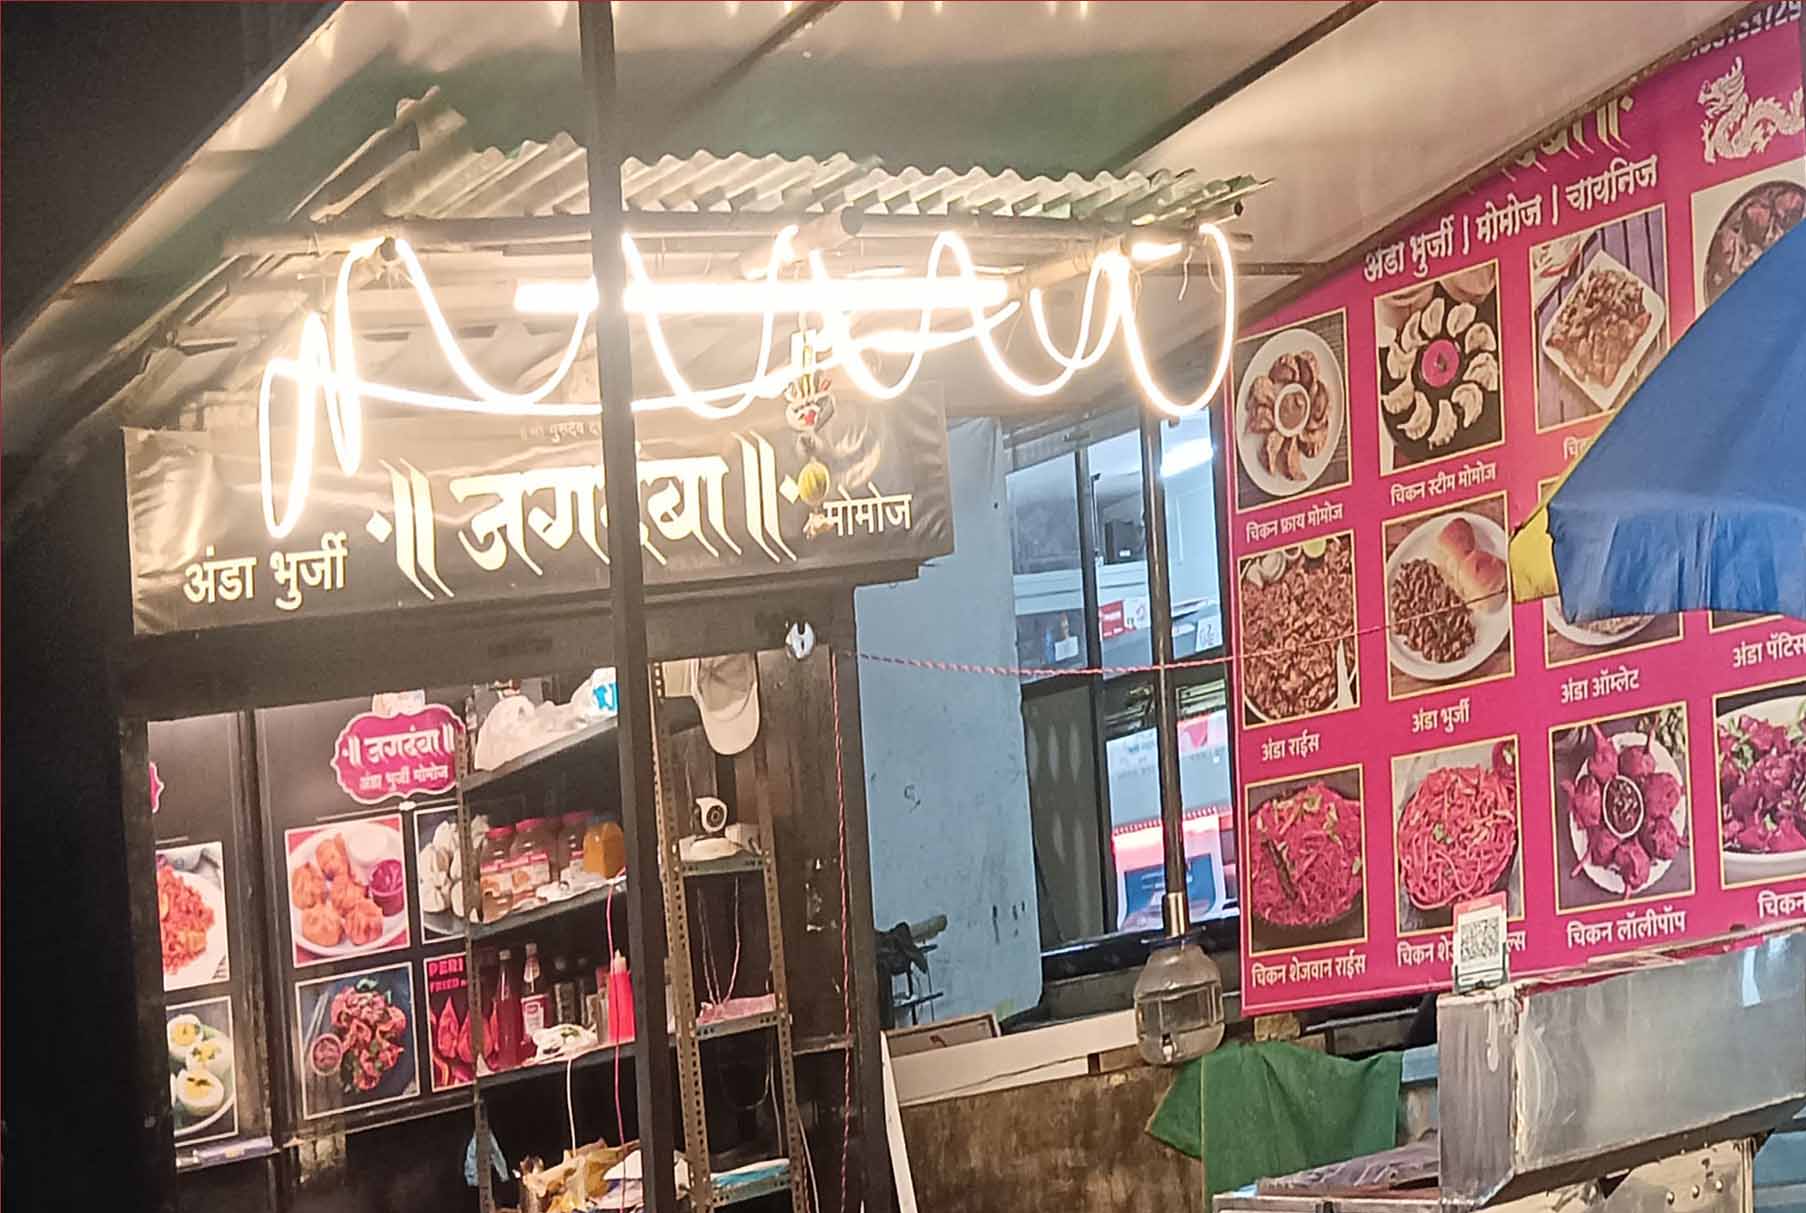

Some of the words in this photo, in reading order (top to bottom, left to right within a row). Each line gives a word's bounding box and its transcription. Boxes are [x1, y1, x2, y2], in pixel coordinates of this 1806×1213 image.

[1476, 192, 1542, 243] मोमोज
[1566, 154, 1658, 211] चायनिज
[1391, 484, 1425, 507] चिकन
[1428, 473, 1455, 496] स्टीम
[1458, 462, 1496, 490] मोमोज
[822, 481, 913, 537] मोमोज
[1246, 520, 1278, 544] चिकन
[1280, 513, 1305, 537] फ्राय
[1307, 502, 1344, 529] मोमोज
[183, 545, 257, 603] अंडा
[270, 531, 348, 610] भुर्जी
[1732, 640, 1762, 667] अंडा
[1561, 677, 1588, 704] अंडा
[1592, 664, 1640, 698] ऑम्लेट
[1412, 708, 1438, 734] अंडा
[1440, 698, 1470, 734] भुर्जी
[1261, 738, 1286, 762] अंडा
[1288, 728, 1320, 759] राईस
[1567, 920, 1613, 949] चिकन
[1616, 906, 1686, 941] लॉलीपॉप
[1252, 964, 1286, 988] चिकन
[1289, 955, 1332, 983] शेजवान
[1335, 949, 1365, 978] राईस
[1397, 941, 1433, 967] चिकन
